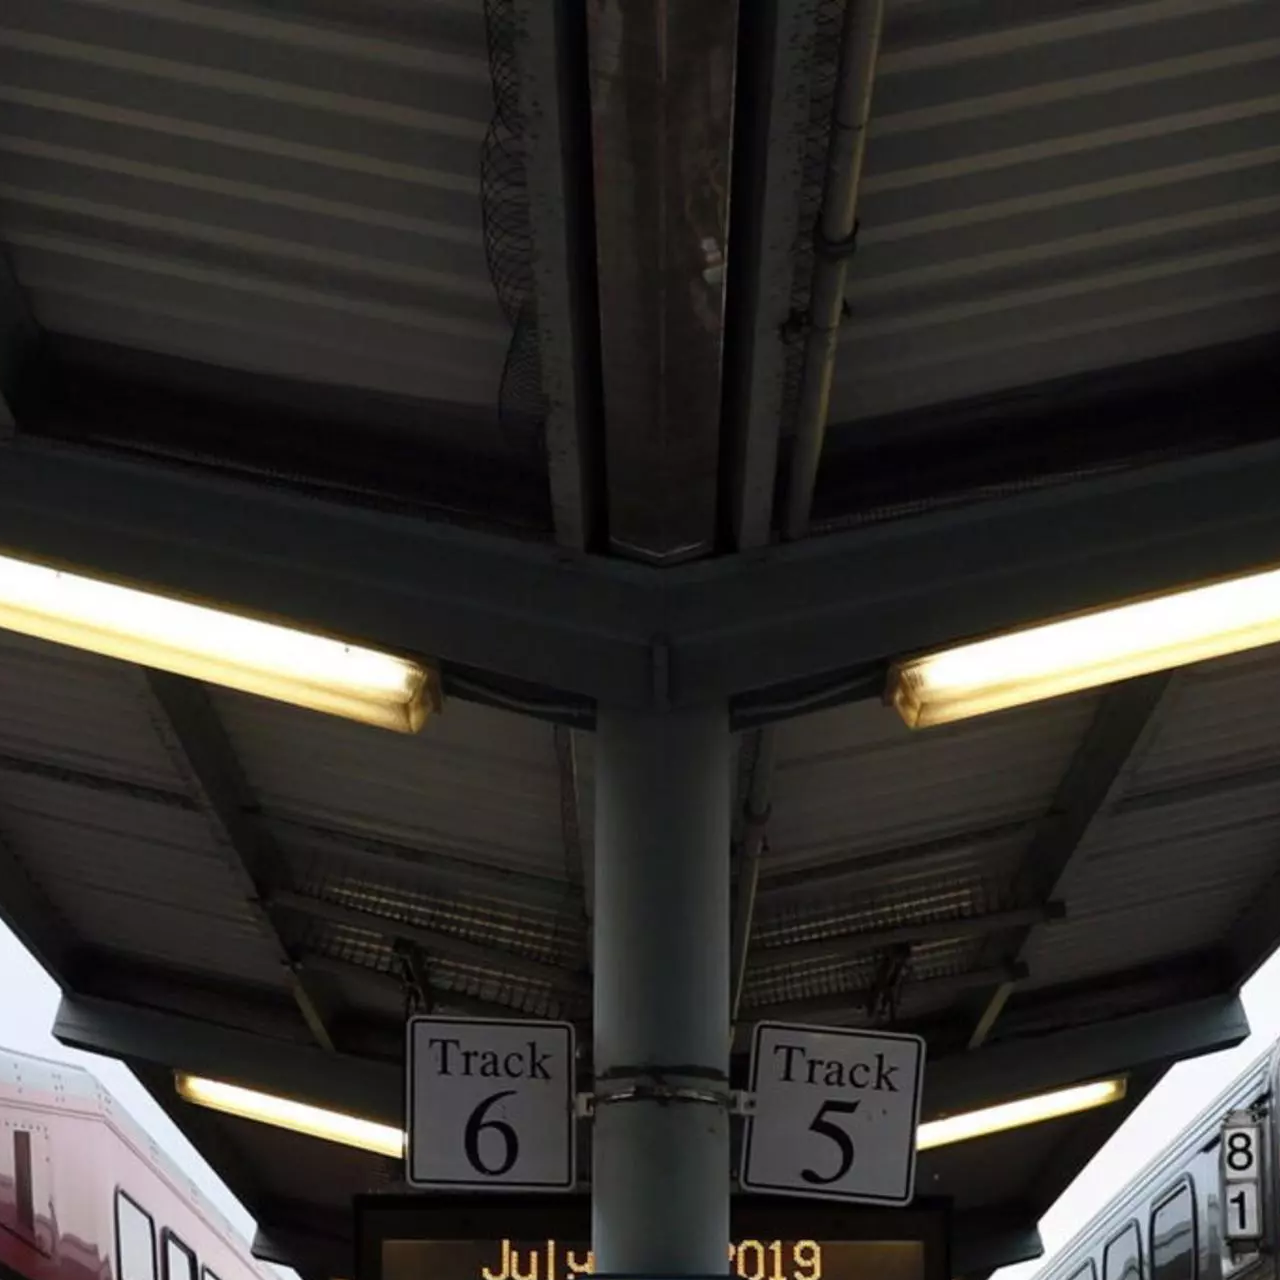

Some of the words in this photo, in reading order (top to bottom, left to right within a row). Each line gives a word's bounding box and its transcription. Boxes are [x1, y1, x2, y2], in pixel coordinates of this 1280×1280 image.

[429, 1038, 552, 1080] Track
[773, 1044, 900, 1092] Track
[464, 1089, 519, 1176] 6
[800, 1099, 862, 1185] 5
